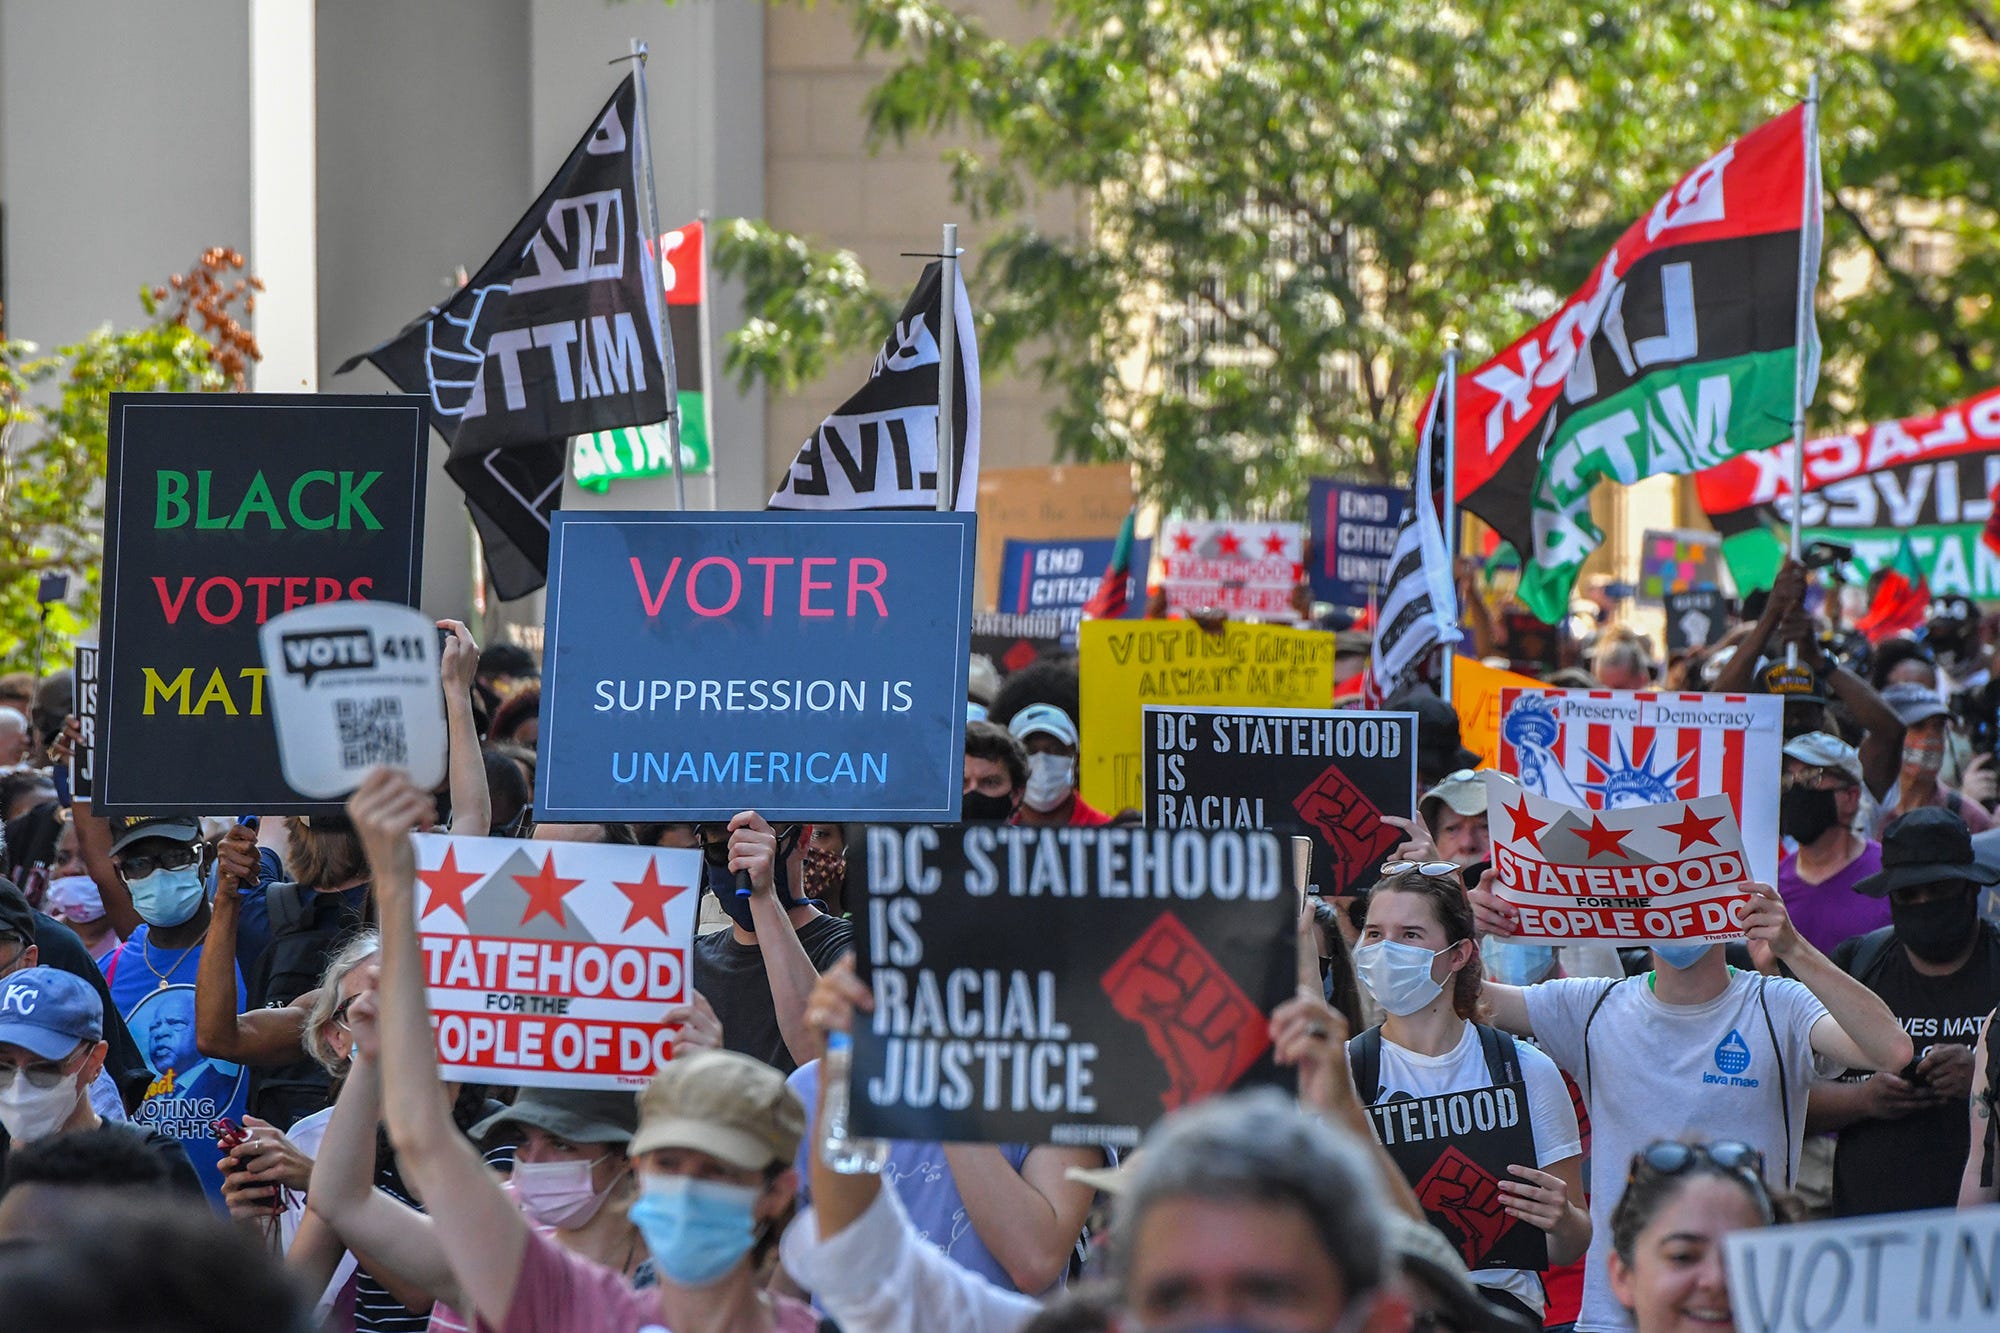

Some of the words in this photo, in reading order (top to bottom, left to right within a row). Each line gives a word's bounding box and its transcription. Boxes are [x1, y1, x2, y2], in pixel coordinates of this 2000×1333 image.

[154, 469, 384, 530] BLACK
[1339, 490, 1388, 521] END
[1035, 548, 1084, 575] END
[630, 556, 889, 617] VOTER
[284, 636, 372, 668] VOTE
[383, 635, 425, 660] 411
[1108, 630, 1247, 665] VOTING
[594, 680, 866, 712] SUPPRESSION
[882, 681, 913, 712] IS
[1563, 701, 1637, 720] Preserve
[1655, 706, 1755, 728] Democracy
[1157, 714, 1198, 750] DC
[1212, 716, 1401, 758] STATEHOOD
[612, 752, 888, 783] UNAMERICAN
[1157, 754, 1186, 791] IS
[1157, 794, 1273, 830] RACIAL
[867, 826, 942, 895] DC
[963, 827, 1282, 900] STATEHOOD
[1499, 848, 1742, 897] STATEHOOD
[1576, 897, 1611, 908] FOR
[1614, 897, 1651, 908] THE
[869, 898, 924, 966] IS
[1511, 907, 1637, 938] EOPLE
[1643, 904, 1694, 936] OF
[2, 984, 39, 1015] KC
[486, 994, 525, 1013] FOR
[530, 997, 569, 1014] THE
[872, 967, 1071, 1039] RACIAL
[432, 1014, 546, 1067] OPLE
[551, 1022, 614, 1071] OF
[1896, 1016, 1938, 1037] VES
[868, 1038, 1099, 1113] JUSTICE
[1703, 1071, 1728, 1085] lava
[1730, 1076, 1760, 1088] mae
